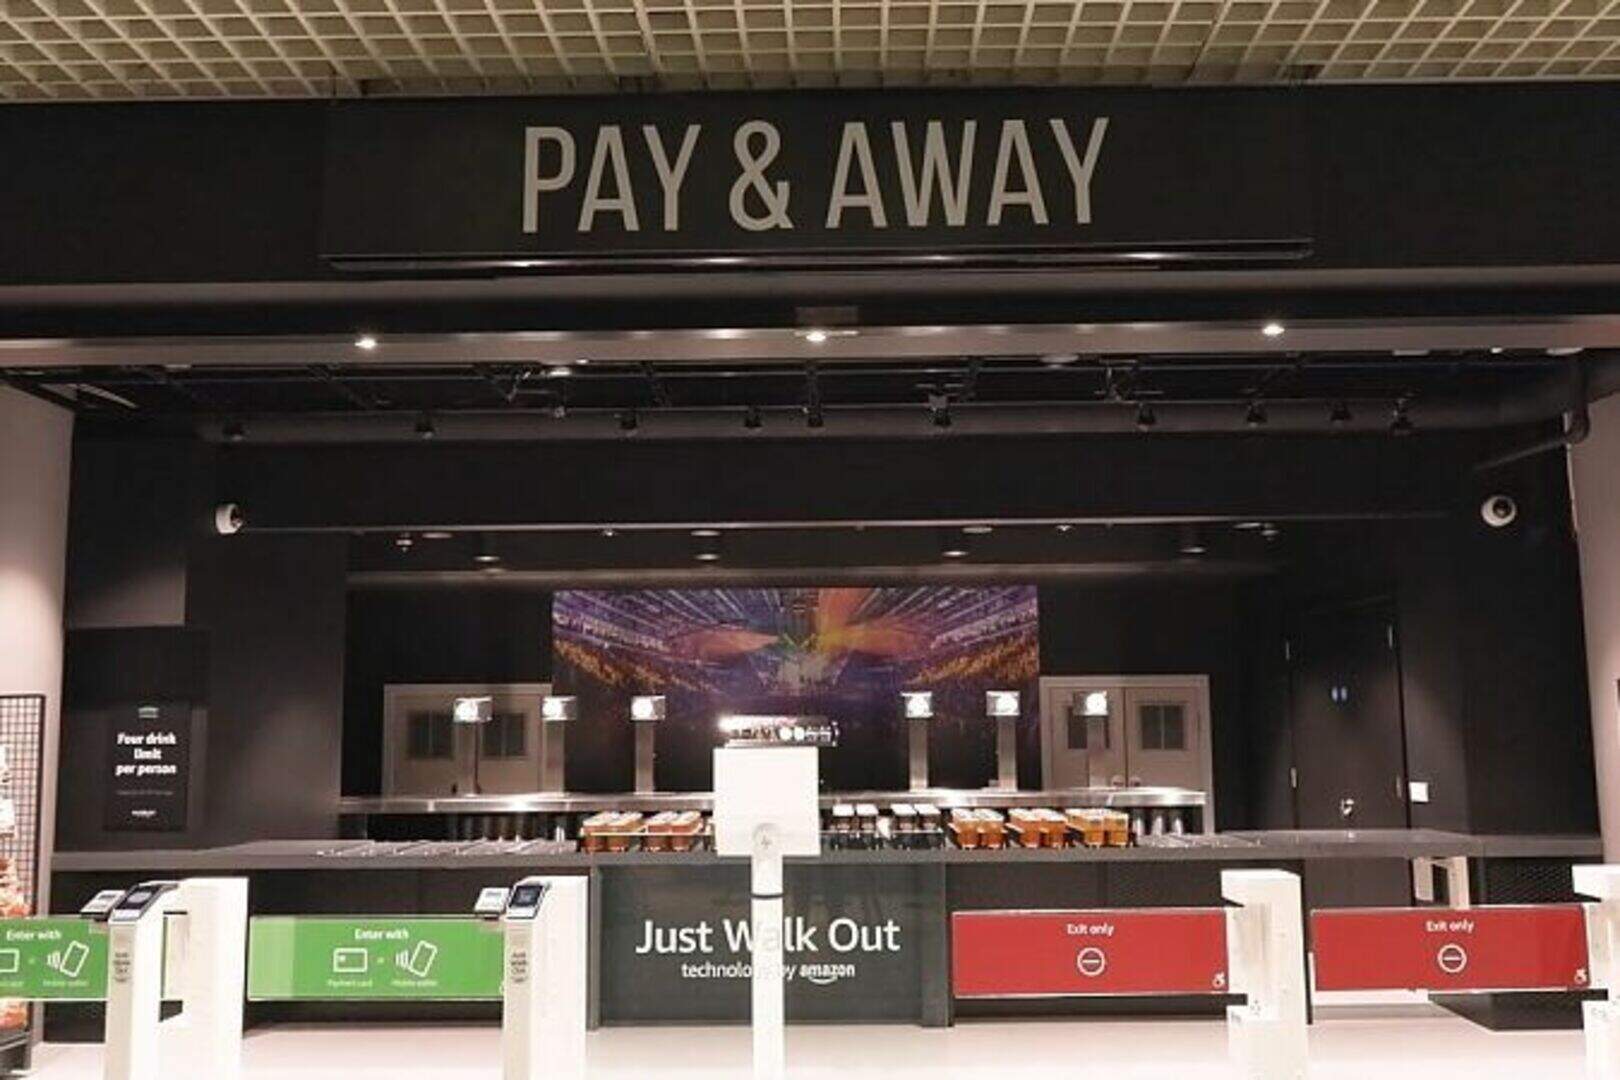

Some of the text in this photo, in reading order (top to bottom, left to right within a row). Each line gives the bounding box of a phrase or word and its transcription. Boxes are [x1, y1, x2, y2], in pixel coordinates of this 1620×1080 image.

[522, 117, 1109, 233] PAY & AWAY
[117, 732, 177, 745] Four drink
[134, 748, 162, 760] limit
[115, 765, 177, 777] per person
[1067, 922, 1114, 937] Exit only
[1427, 919, 1474, 934] Exit only
[6, 929, 61, 940] Enter with
[355, 928, 409, 940] Enter with
[635, 917, 901, 954] Just Wlk Out
[681, 961, 753, 979] technolo
[799, 963, 856, 982] amazon
